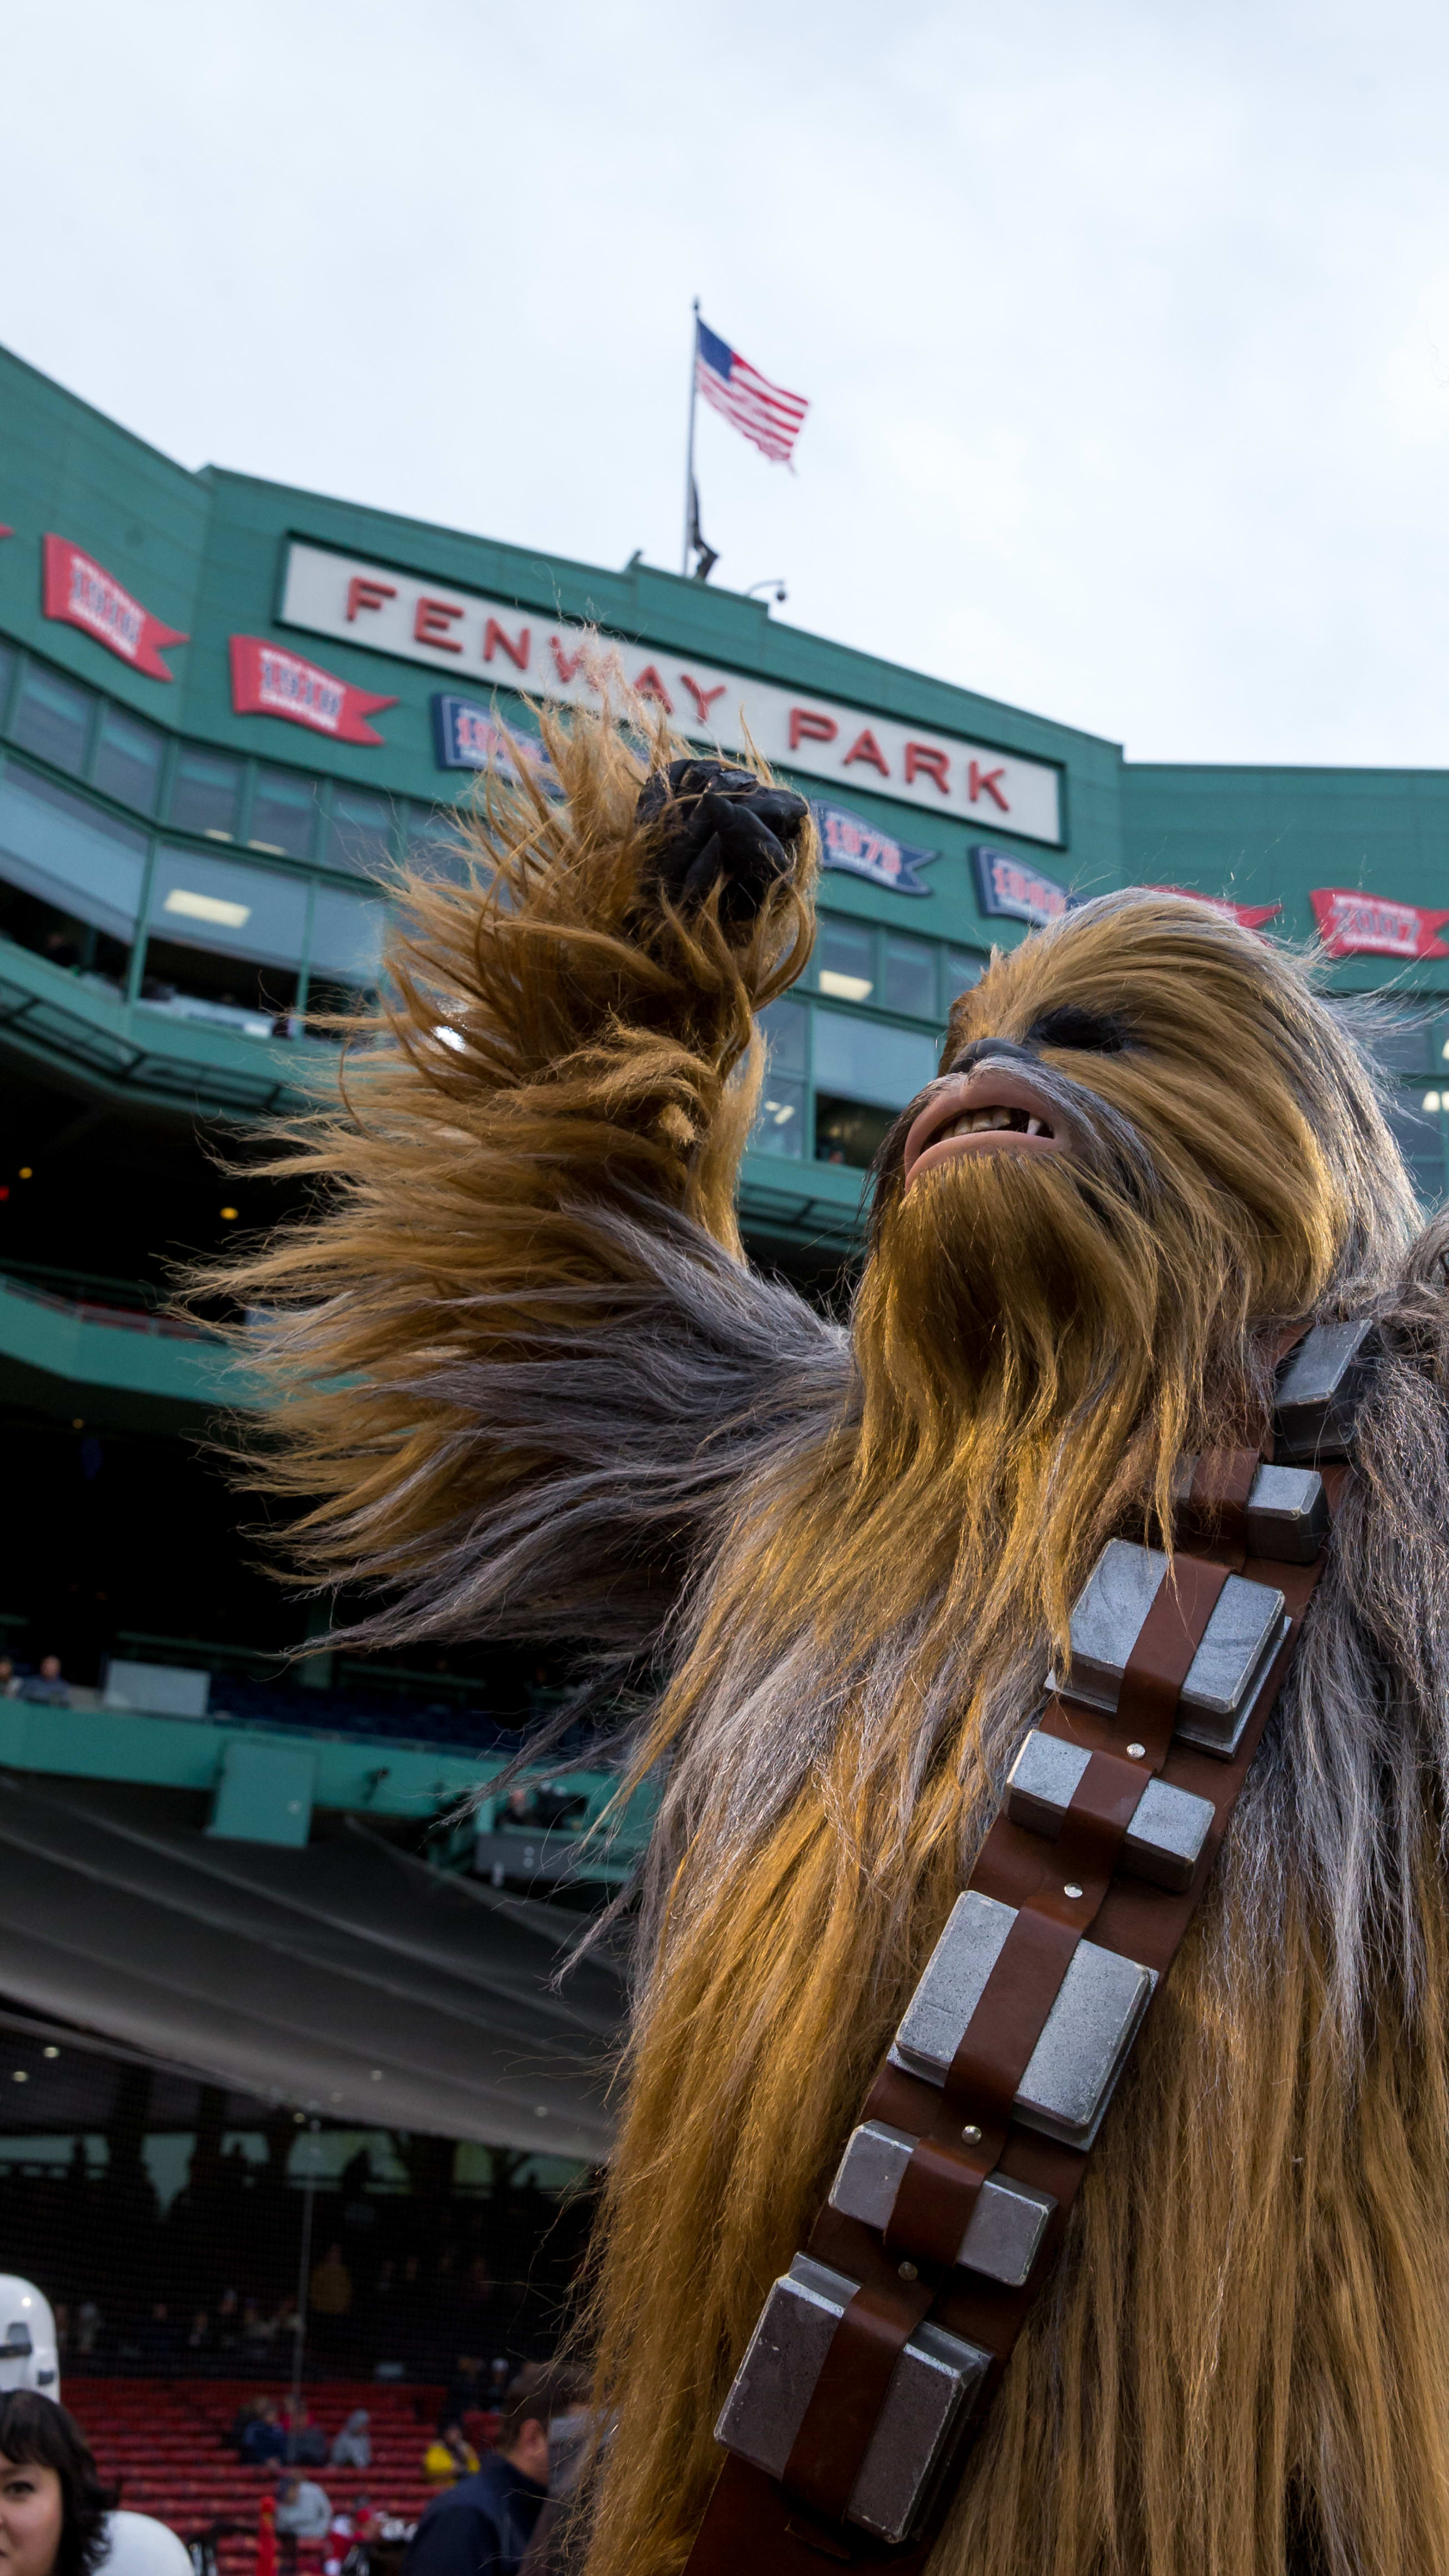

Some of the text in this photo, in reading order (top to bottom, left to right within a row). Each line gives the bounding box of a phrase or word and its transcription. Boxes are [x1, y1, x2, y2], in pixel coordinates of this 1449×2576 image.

[346, 575, 1010, 812] FENWAY PARK
[1329, 905, 1422, 942] 2007
